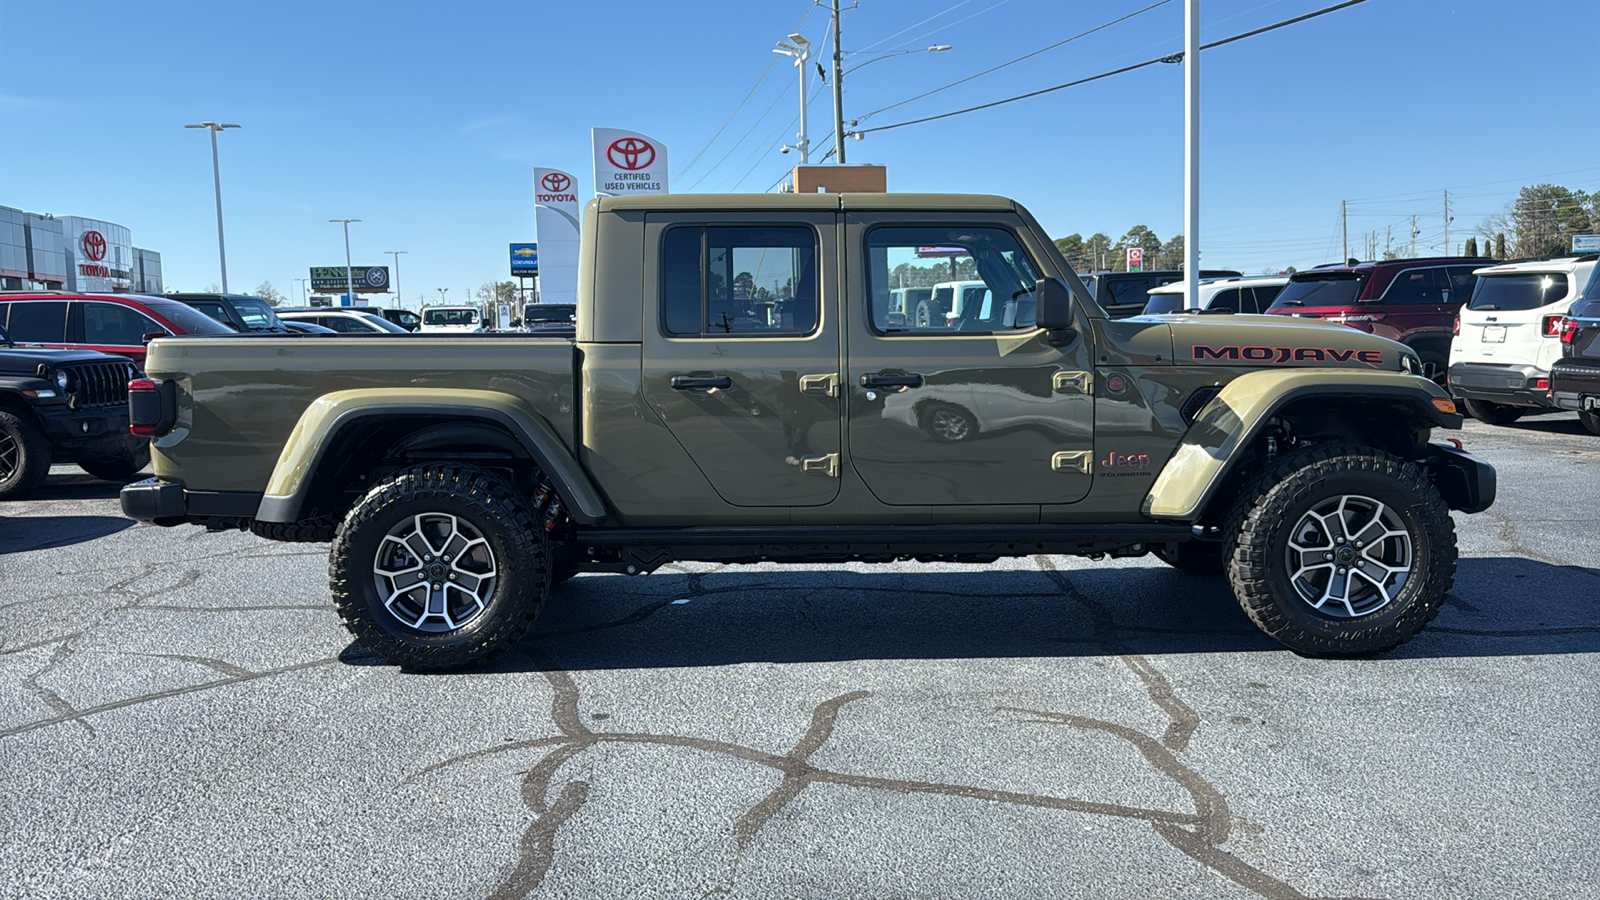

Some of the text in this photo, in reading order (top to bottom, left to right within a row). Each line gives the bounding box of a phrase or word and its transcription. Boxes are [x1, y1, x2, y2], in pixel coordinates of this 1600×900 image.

[614, 172, 651, 181] CERTIFIED
[604, 182, 661, 191] USED VEHICLES
[536, 193, 577, 203] TOYOTA
[81, 264, 110, 278] TOYOTA
[1192, 345, 1385, 364] MOJAVE
[1102, 451, 1151, 470] Jeep
